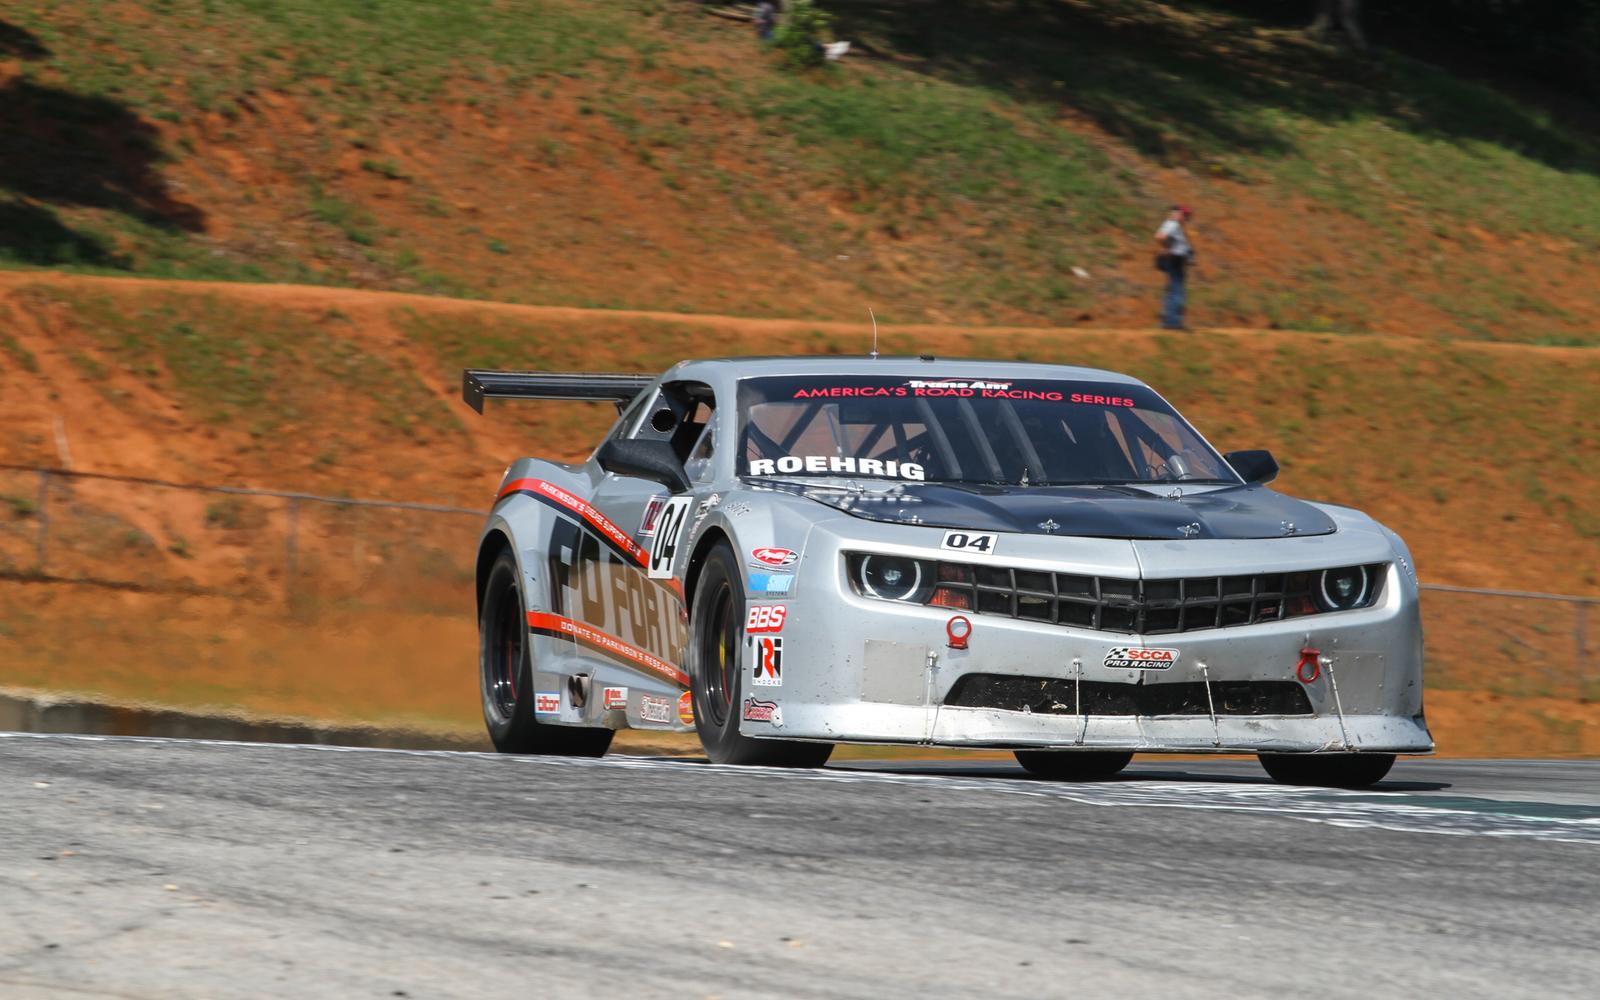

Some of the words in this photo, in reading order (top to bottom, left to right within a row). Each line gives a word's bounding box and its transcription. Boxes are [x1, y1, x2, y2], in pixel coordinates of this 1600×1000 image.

[793, 386, 907, 399] AMERICA'S
[914, 387, 974, 398] ROAD
[981, 389, 1063, 401] RACING
[1071, 394, 1135, 408] SERIES
[749, 455, 926, 481] ROEHRIG
[651, 503, 688, 572] 04
[945, 533, 991, 552] 04
[747, 605, 786, 632] BBS
[560, 621, 591, 639] DONATE
[592, 633, 602, 643] TO
[1106, 659, 1129, 668] PRO
[1131, 660, 1172, 669] RACING
[1128, 649, 1174, 661] SCCA
